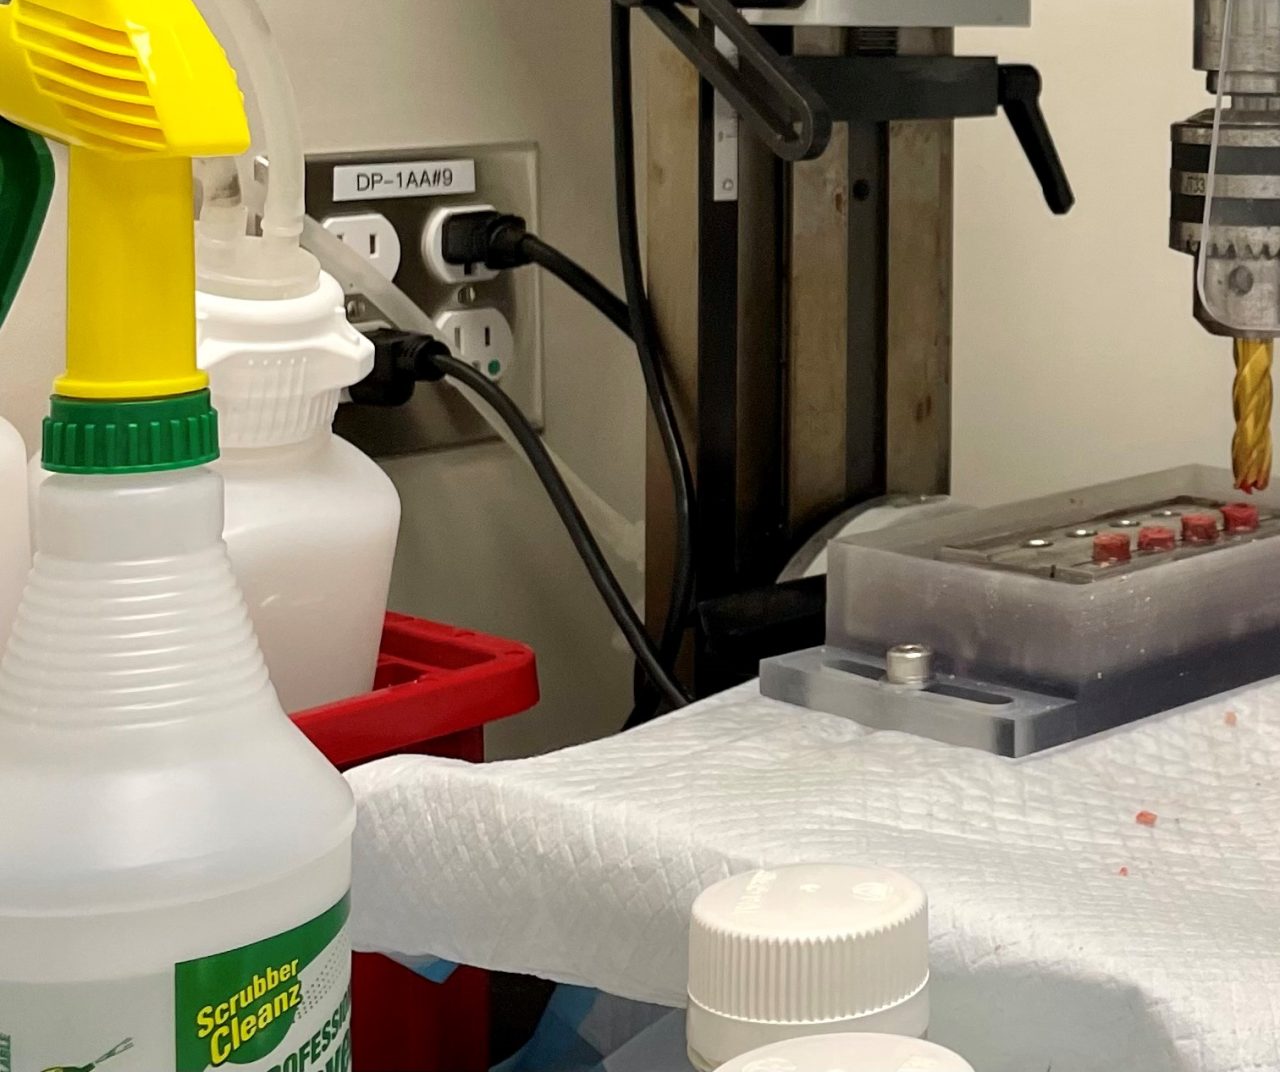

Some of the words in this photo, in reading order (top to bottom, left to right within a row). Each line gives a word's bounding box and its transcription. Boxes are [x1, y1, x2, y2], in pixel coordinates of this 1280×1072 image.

[357, 168, 453, 192] DP-1AA#9
[197, 959, 299, 1038] Scrubber
[210, 983, 302, 1067] Cleanz
